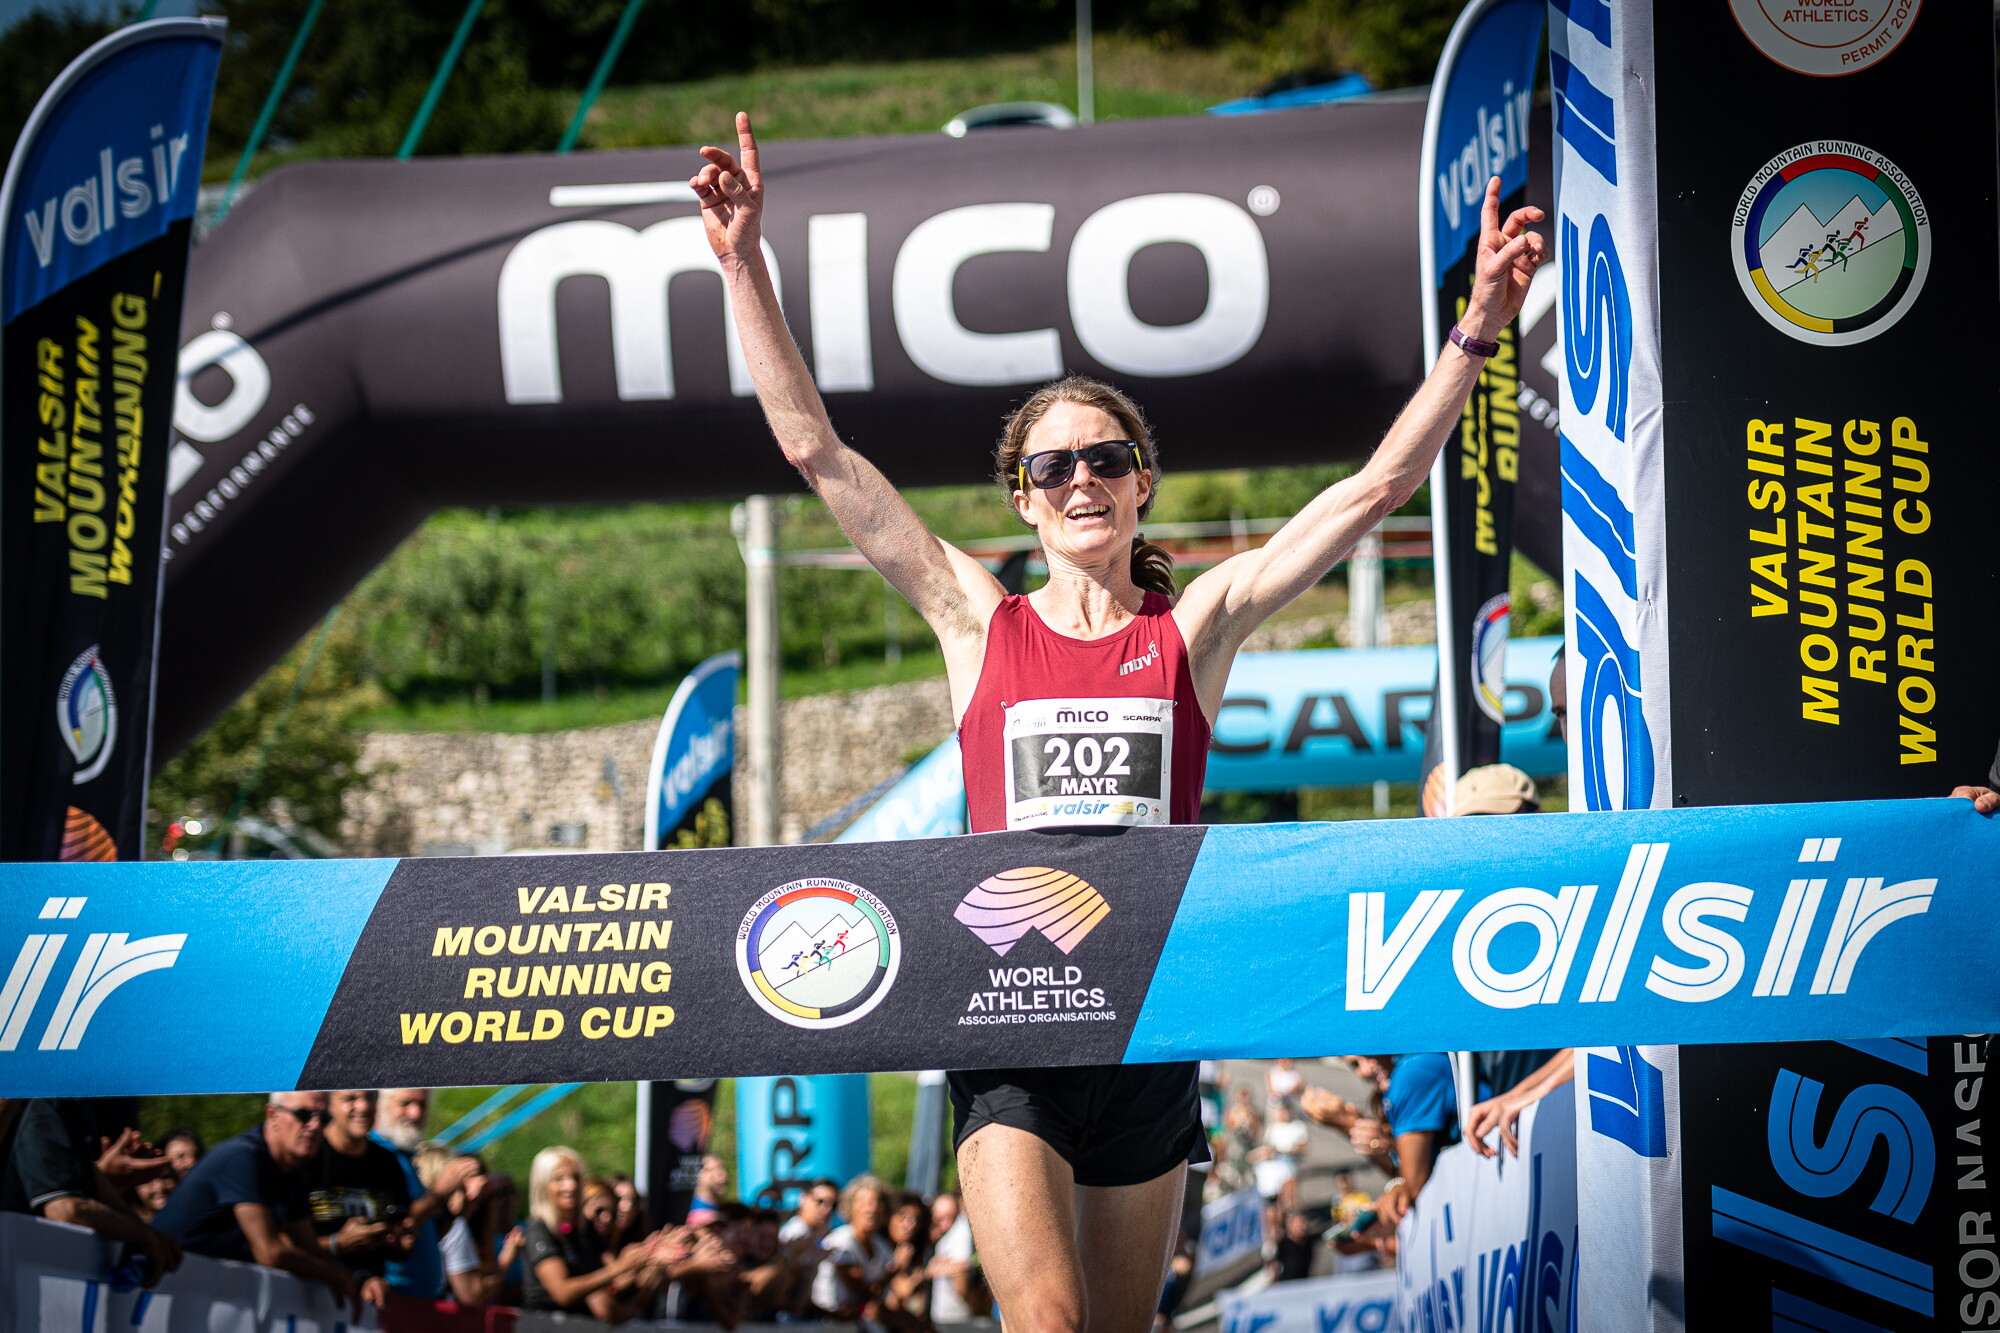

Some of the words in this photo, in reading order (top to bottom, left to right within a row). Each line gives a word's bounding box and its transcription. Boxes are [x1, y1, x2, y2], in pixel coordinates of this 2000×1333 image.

[1783, 9, 1869, 23] ATHLETICS
[1840, 27, 1894, 66] PERMIT
[1437, 79, 1531, 230] valsir
[25, 124, 190, 268] valsir
[1733, 185, 1758, 228] WORLD
[1755, 143, 1814, 185] MOUNTAIN
[1817, 141, 1874, 162] RUNNING
[1874, 156, 1928, 227] ASSOCIATION
[33, 337, 67, 523] VALSIR
[67, 315, 109, 599] MOUNTAIN
[1891, 415, 1933, 534] CUP
[1746, 417, 1788, 618] VALSIR
[1795, 416, 1840, 726] MOUNTAIN
[1842, 418, 1887, 684] RUNNING
[1895, 558, 1937, 765] WORLD
[1122, 714, 1162, 722] SCARPA
[1043, 736, 1131, 777] 202
[1060, 777, 1119, 795] MAYR
[1053, 799, 1110, 816] valsir
[516, 882, 672, 914] VALSIR
[738, 910, 758, 941] WORLD
[755, 881, 803, 910] MOUNTAIN
[805, 878, 852, 892] RUNNING
[853, 887, 898, 936] ASSOCIATION
[431, 920, 673, 957] MOUNTAIN
[1345, 837, 1938, 1011] valsir
[463, 962, 672, 999] RUNNING
[988, 965, 1083, 988] WORLD
[957, 1014, 1027, 1026] ASSOCIATED
[1028, 1011, 1117, 1024] ORGANISATIONS
[967, 987, 1106, 1012] ATHLETICS
[399, 1007, 565, 1045] WORLD
[579, 1004, 676, 1040] CUP
